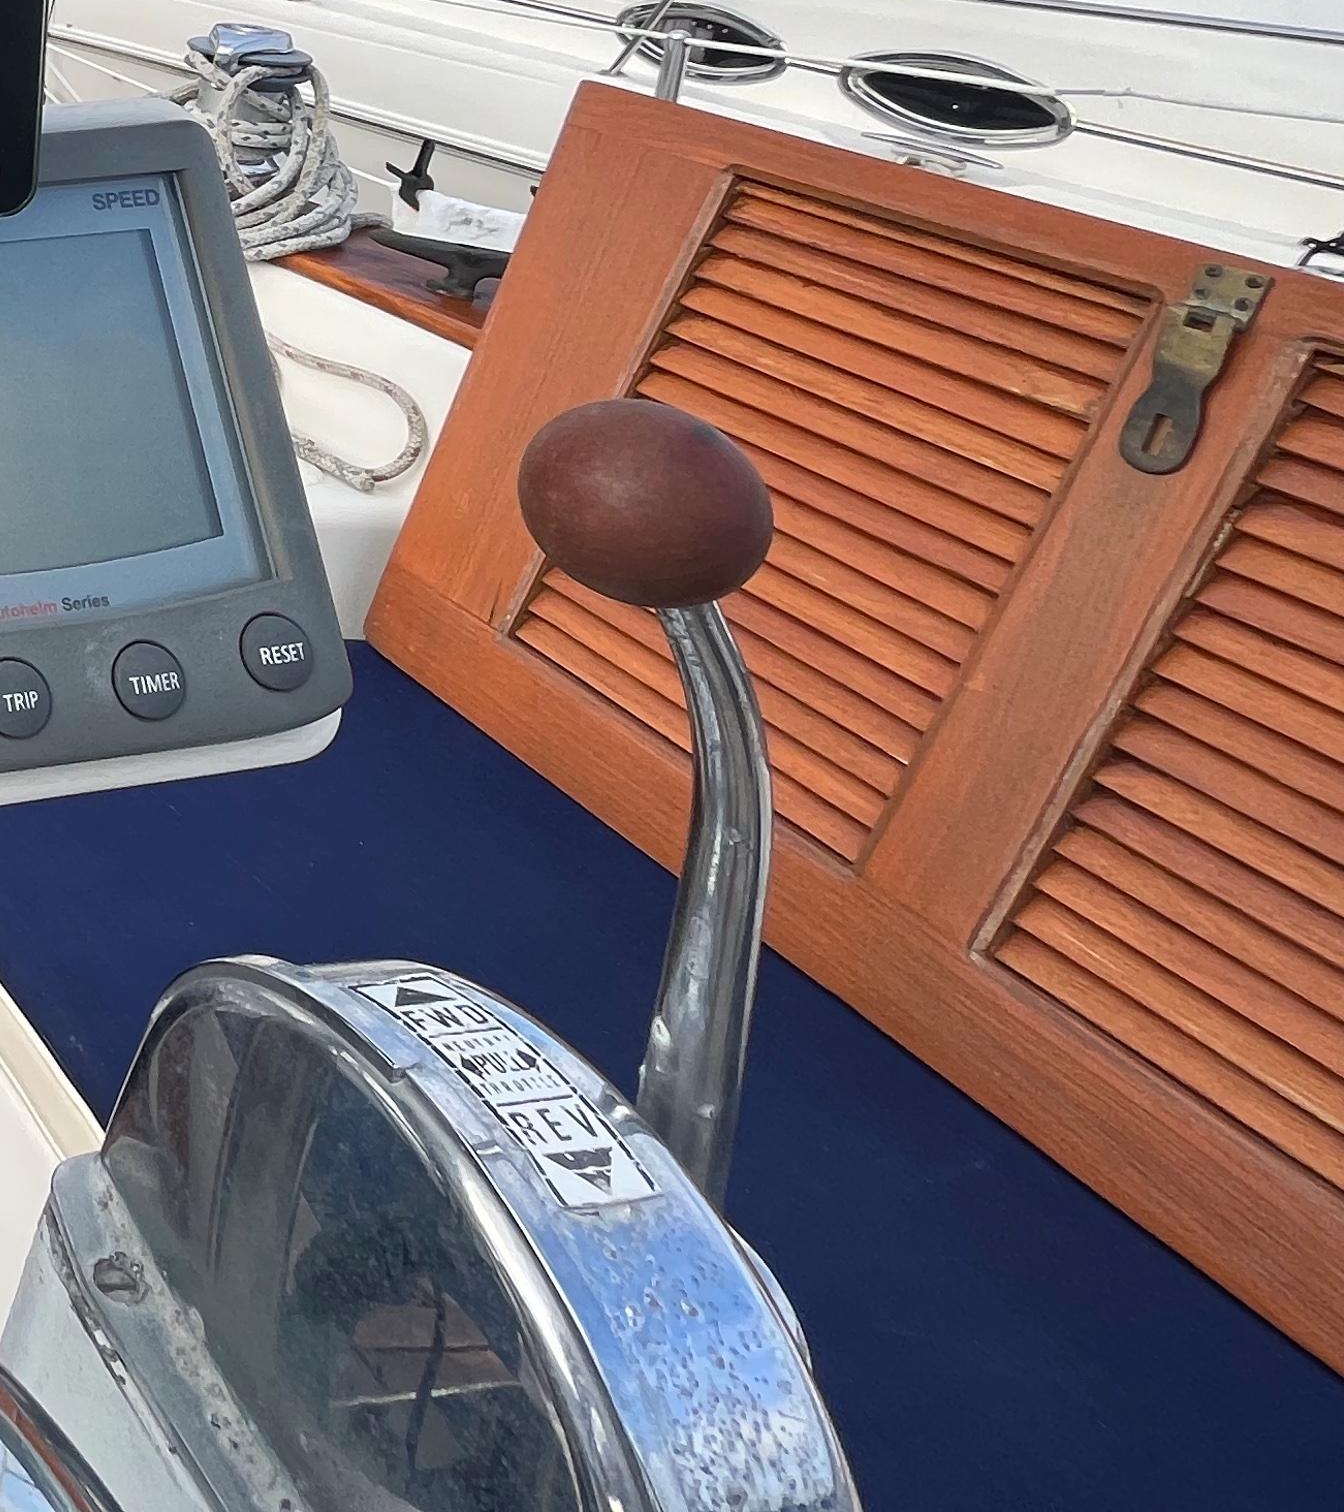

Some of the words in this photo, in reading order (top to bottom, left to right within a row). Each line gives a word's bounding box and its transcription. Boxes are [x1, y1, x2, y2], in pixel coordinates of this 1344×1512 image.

[92, 189, 161, 211] SPEED
[61, 593, 111, 614] Series
[258, 640, 305, 666] RESET
[128, 670, 181, 696] TIMER
[2, 688, 40, 713] TRIP
[399, 1004, 489, 1032] FWD
[507, 1104, 599, 1146] REV
